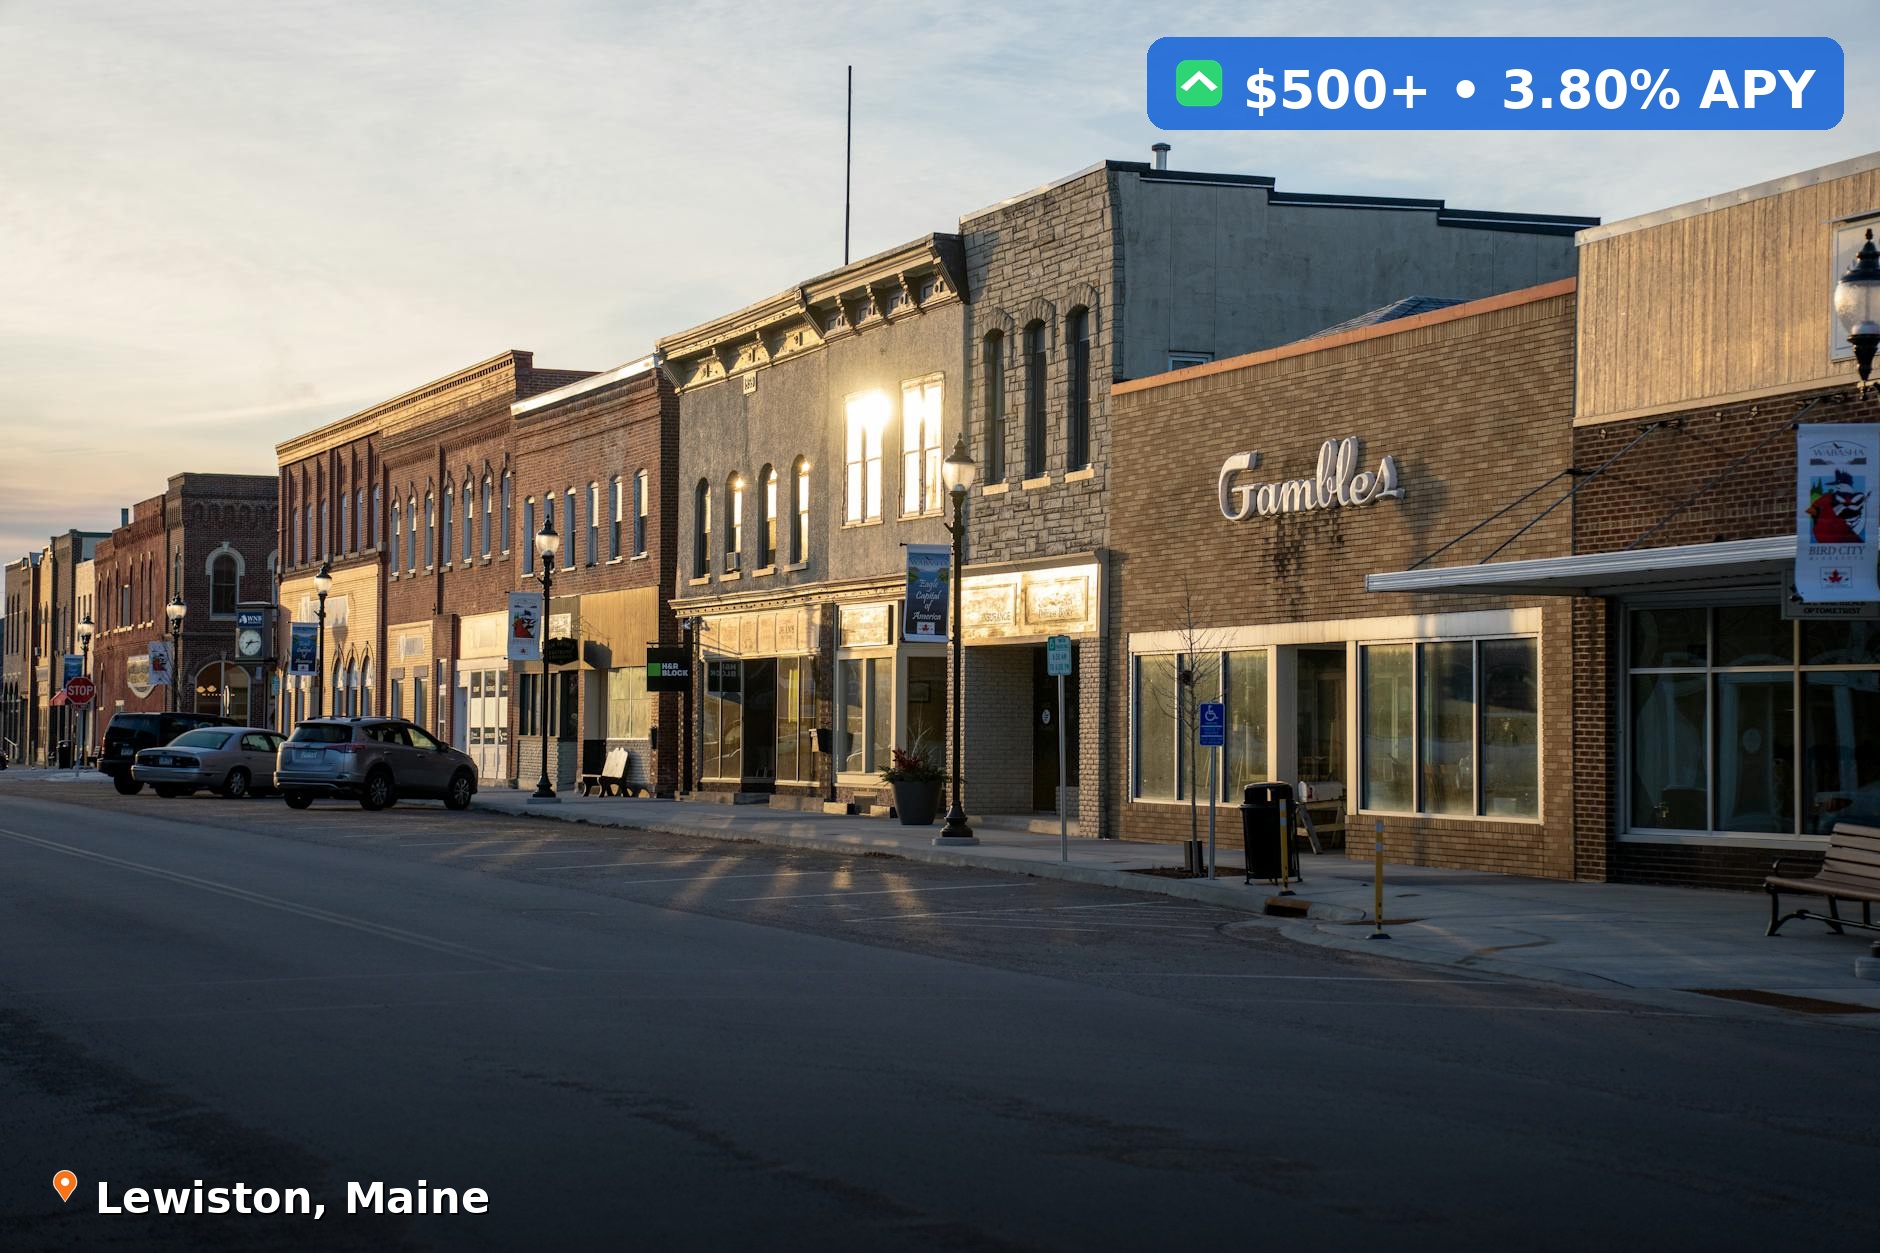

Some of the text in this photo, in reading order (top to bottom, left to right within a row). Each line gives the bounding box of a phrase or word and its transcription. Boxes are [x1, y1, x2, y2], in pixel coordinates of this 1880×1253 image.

[1218, 436, 1405, 521] Gambles
[1809, 545, 1865, 556] BIRD CITY
[919, 579, 939, 592] Eagle
[915, 591, 942, 603] Capital
[924, 600, 934, 612] of
[1803, 607, 1861, 615] OPTOMETRIST
[912, 611, 942, 620] America
[661, 669, 689, 677] BLOCK
[68, 685, 93, 696] STOP
